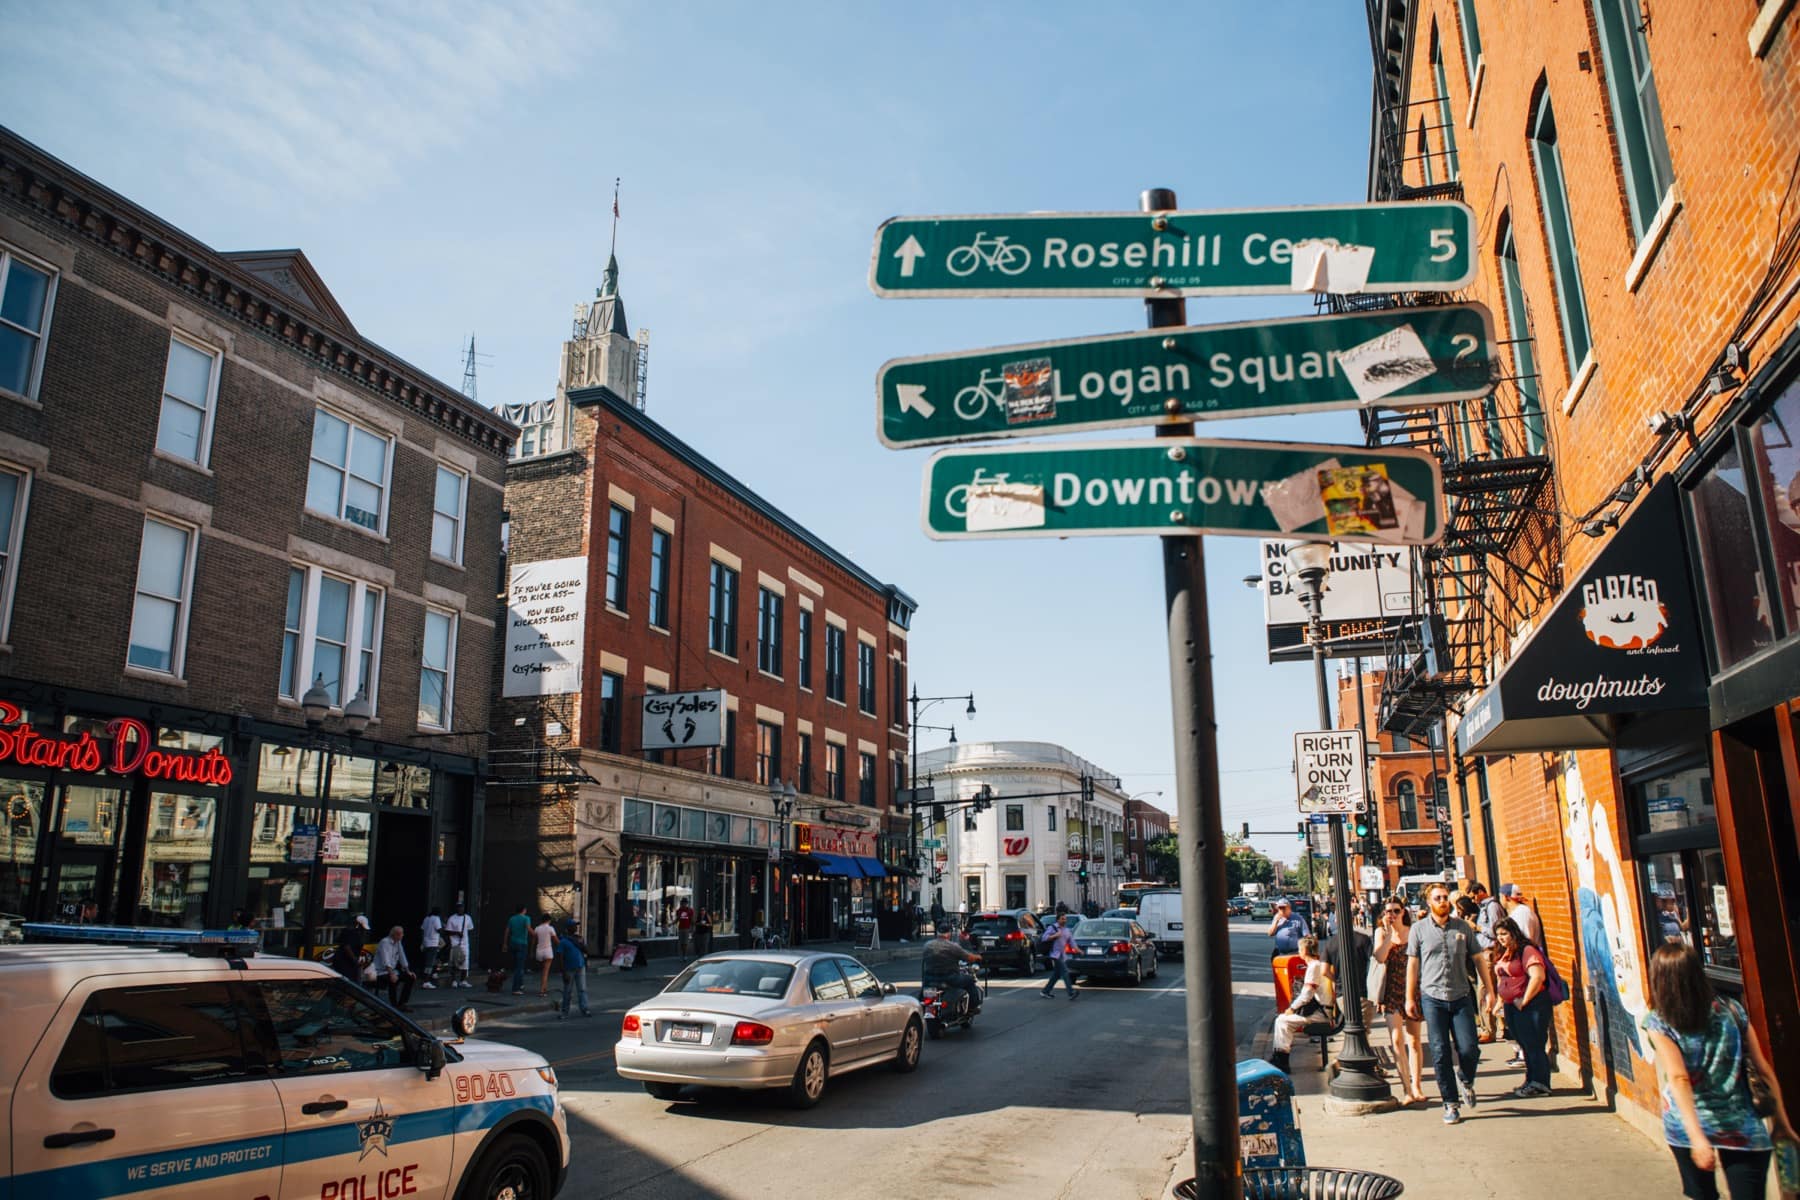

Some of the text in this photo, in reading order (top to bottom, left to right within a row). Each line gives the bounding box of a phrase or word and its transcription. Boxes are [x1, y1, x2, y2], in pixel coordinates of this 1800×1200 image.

[1043, 234, 1221, 269] Rosehill
[1430, 229, 1457, 262] 5
[1054, 363, 1190, 406] Logan
[1209, 349, 1343, 394] Squar
[1451, 333, 1479, 371] 2
[1128, 406, 1146, 415] CITY
[1054, 469, 1268, 507] Downtow
[1268, 551, 1400, 577] CUNITY
[554, 579, 581, 590] GOING
[1582, 575, 1659, 608] GLAZED
[527, 607, 541, 617] YOU
[1537, 673, 1666, 711] doughnuts
[105, 717, 233, 786] Donuts
[1303, 736, 1352, 752] RIGHT
[1308, 769, 1351, 784] ONLY
[1317, 784, 1351, 795] XCEPT
[1004, 837, 1029, 856] W
[456, 1073, 516, 1103] 9040
[127, 1145, 272, 1180] WE SERVE AND PROTECT
[320, 1163, 419, 1200] POLICE
